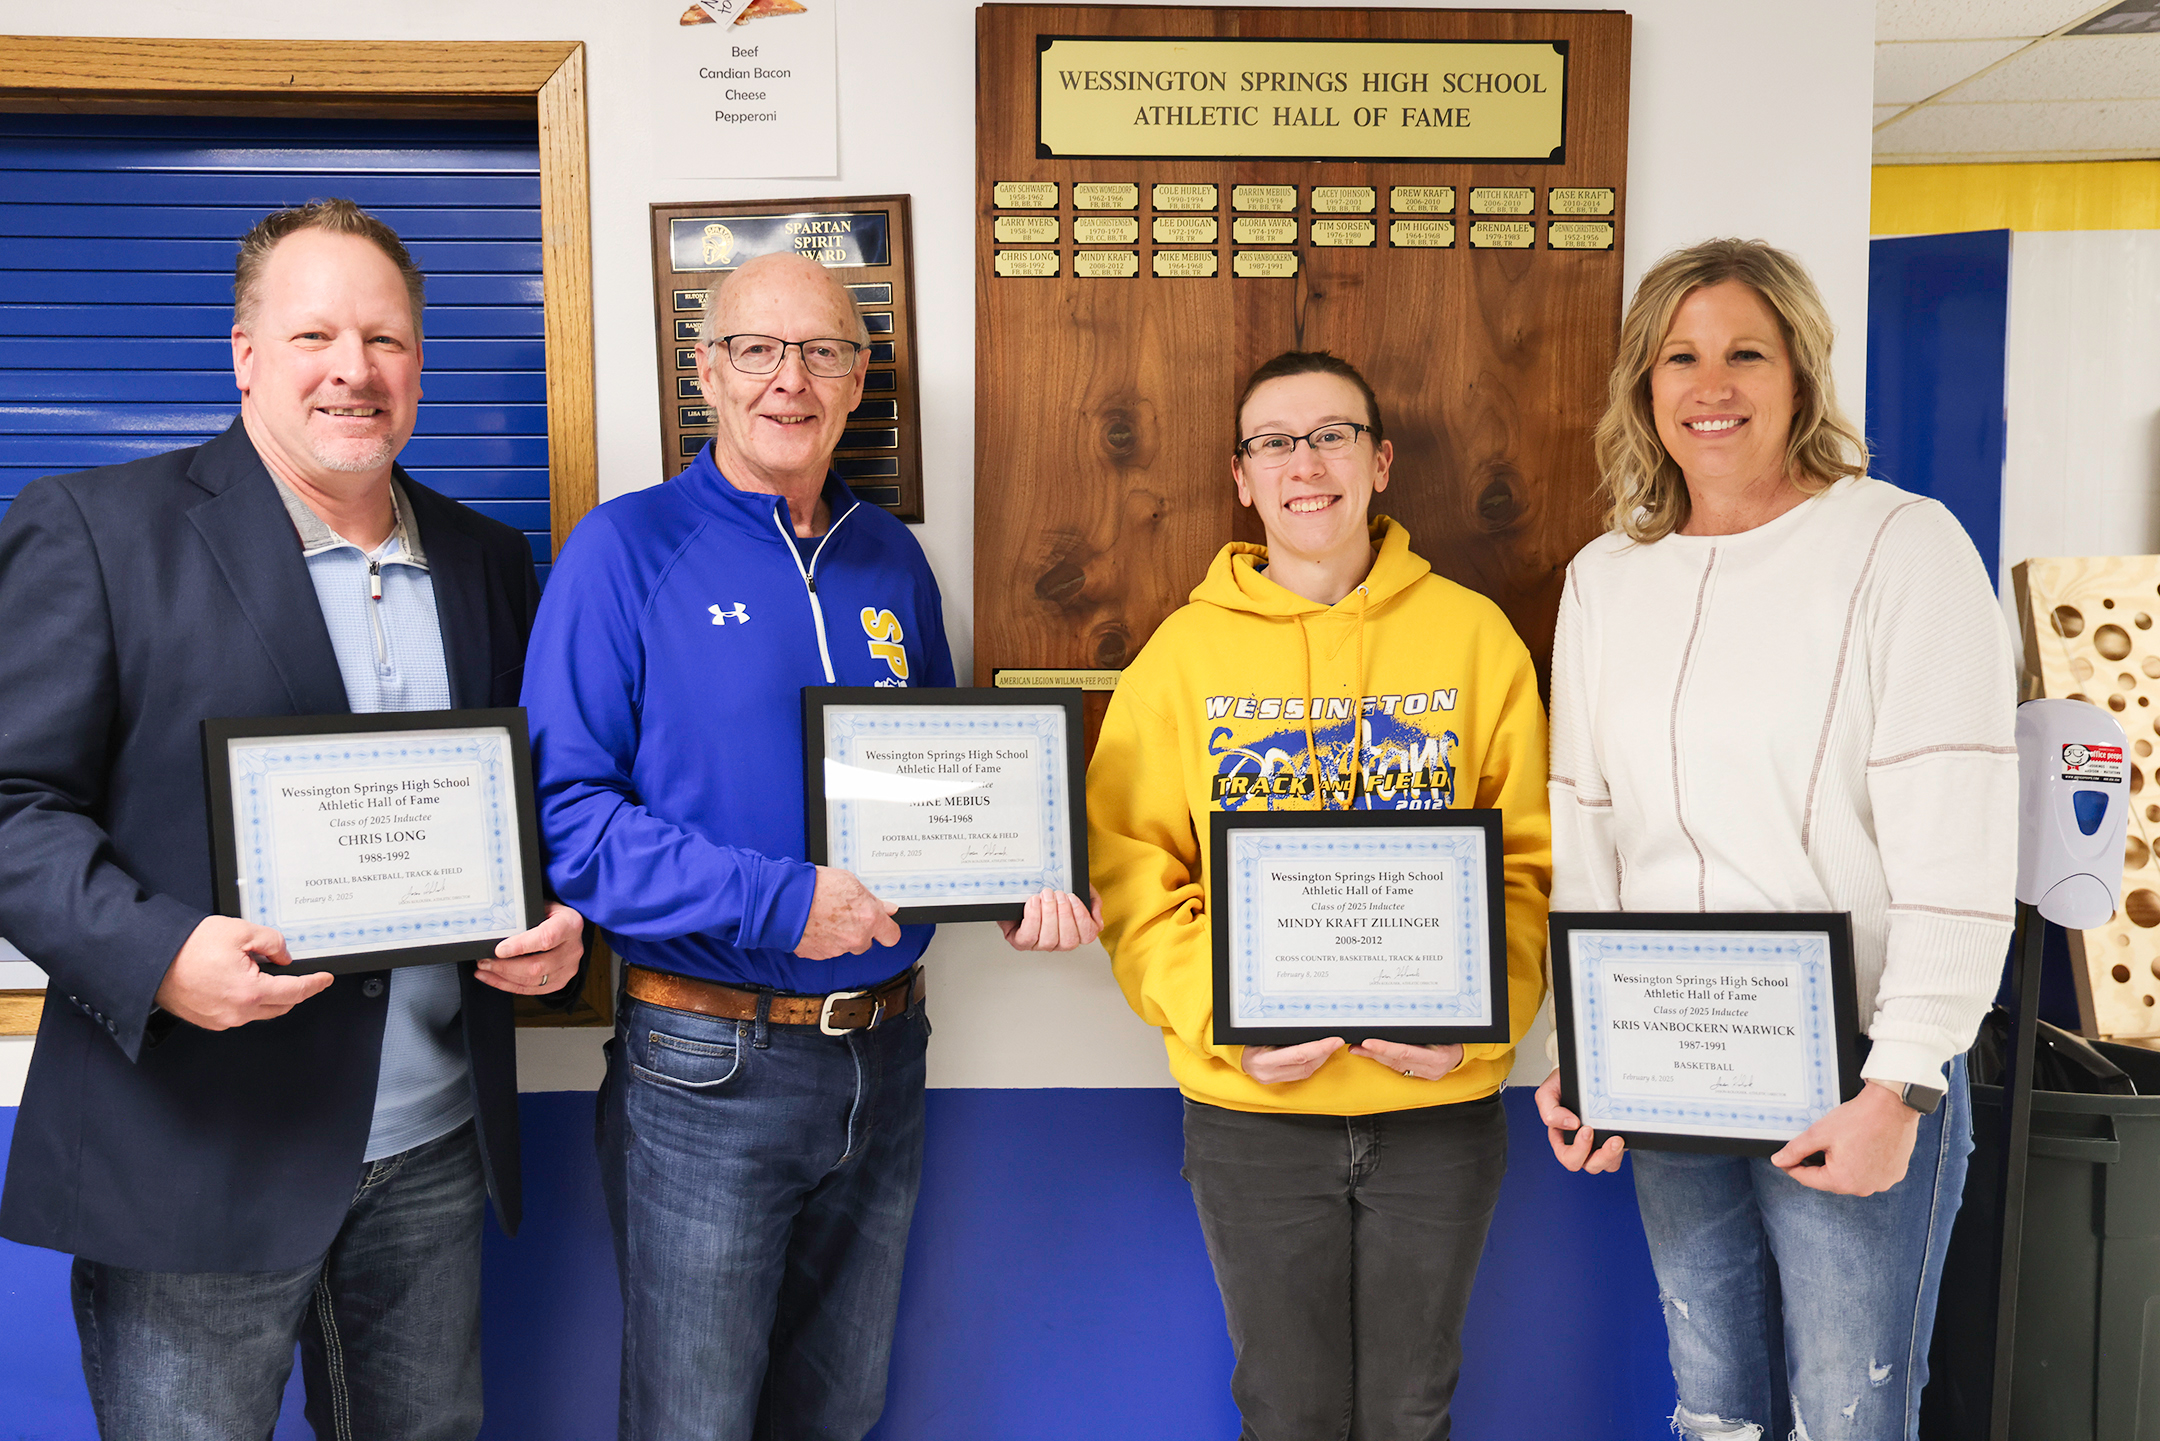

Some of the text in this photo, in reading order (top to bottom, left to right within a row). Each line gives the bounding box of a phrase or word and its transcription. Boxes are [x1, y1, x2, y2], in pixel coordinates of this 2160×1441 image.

[731, 46, 759, 58] Beef
[699, 67, 791, 80] Candian Bacon
[1059, 71, 1547, 94] WESSINGTON SPRINGS HIGH SCHOOL
[725, 89, 766, 101] Cheese
[715, 110, 777, 124] Pepperoni
[1133, 106, 1471, 127] ATHLETIC HALL OF FAME
[1000, 184, 1053, 193] GARY SCHWARTZ
[1159, 187, 1212, 195] COLE HURLEY
[1238, 188, 1291, 196] DARRIN MEBIUS
[1318, 189, 1370, 199] LACEY JOHNSON
[1397, 189, 1450, 197] DREW KRAFT
[1476, 191, 1529, 199] MITCH KRAFT
[1555, 191, 1608, 200] JASE KRAFT
[784, 220, 851, 235] SPARTAN
[1159, 219, 1212, 227] LEE DOUGAN
[1239, 219, 1292, 227] GLORIA VAVRA
[1317, 222, 1370, 230] TIM SORSEN
[1396, 223, 1449, 232] JIM HIGGINS
[1476, 224, 1529, 233] BRENDA LEE
[794, 235, 843, 249] SPIRIT
[1001, 253, 1054, 261] CHRIS LONG
[1080, 253, 1133, 261] MINDY KRAFT
[1159, 253, 1212, 261] MIKE MEBIUS
[1240, 253, 1292, 262] KRIS VANBOCKERN
[999, 677, 1031, 685] AMERICAN
[1032, 676, 1054, 685] LEGION
[1055, 676, 1097, 685] WILLMAN-FEE
[1097, 677, 1113, 685] POST
[1205, 688, 1458, 720] WESSINGTON
[865, 749, 1028, 762] Wessington Springs High School
[896, 763, 1001, 774] Athletic Hall of Fame
[281, 777, 470, 799] Wessington Springs High School
[1217, 776, 1309, 797] TRACK
[1365, 770, 1450, 792] FIELD
[318, 794, 440, 812] Athletic Hall of Fame
[944, 796, 990, 807] MEBIUS
[1395, 799, 1444, 811] 2012
[928, 814, 973, 824] 1964-1968
[338, 829, 426, 847] CHRIS LONG
[358, 851, 410, 863] 1988-1992
[305, 875, 349, 887] FOOTBALL,
[351, 872, 404, 884] BASKETBALL,
[406, 870, 432, 879] TRACK
[441, 867, 462, 876] FIELD
[1271, 871, 1444, 883] Wessington Springs High School
[1302, 885, 1414, 895] Athletic Hall of Fame
[1311, 902, 1405, 912] Class of 2025 Inductee
[1277, 918, 1440, 928] MINDY KRAFT ZILLINGER
[1335, 935, 1382, 945] 2008-2012
[1612, 973, 1789, 989] Wessington Springs High School
[1643, 989, 1757, 1002] Athletic Hall of Fame
[1612, 1020, 1795, 1036] KRIS VANBOCKERN WARWICK
[1678, 1040, 1727, 1051] 1987-1991
[1673, 1061, 1734, 1072] BASKETBALL
